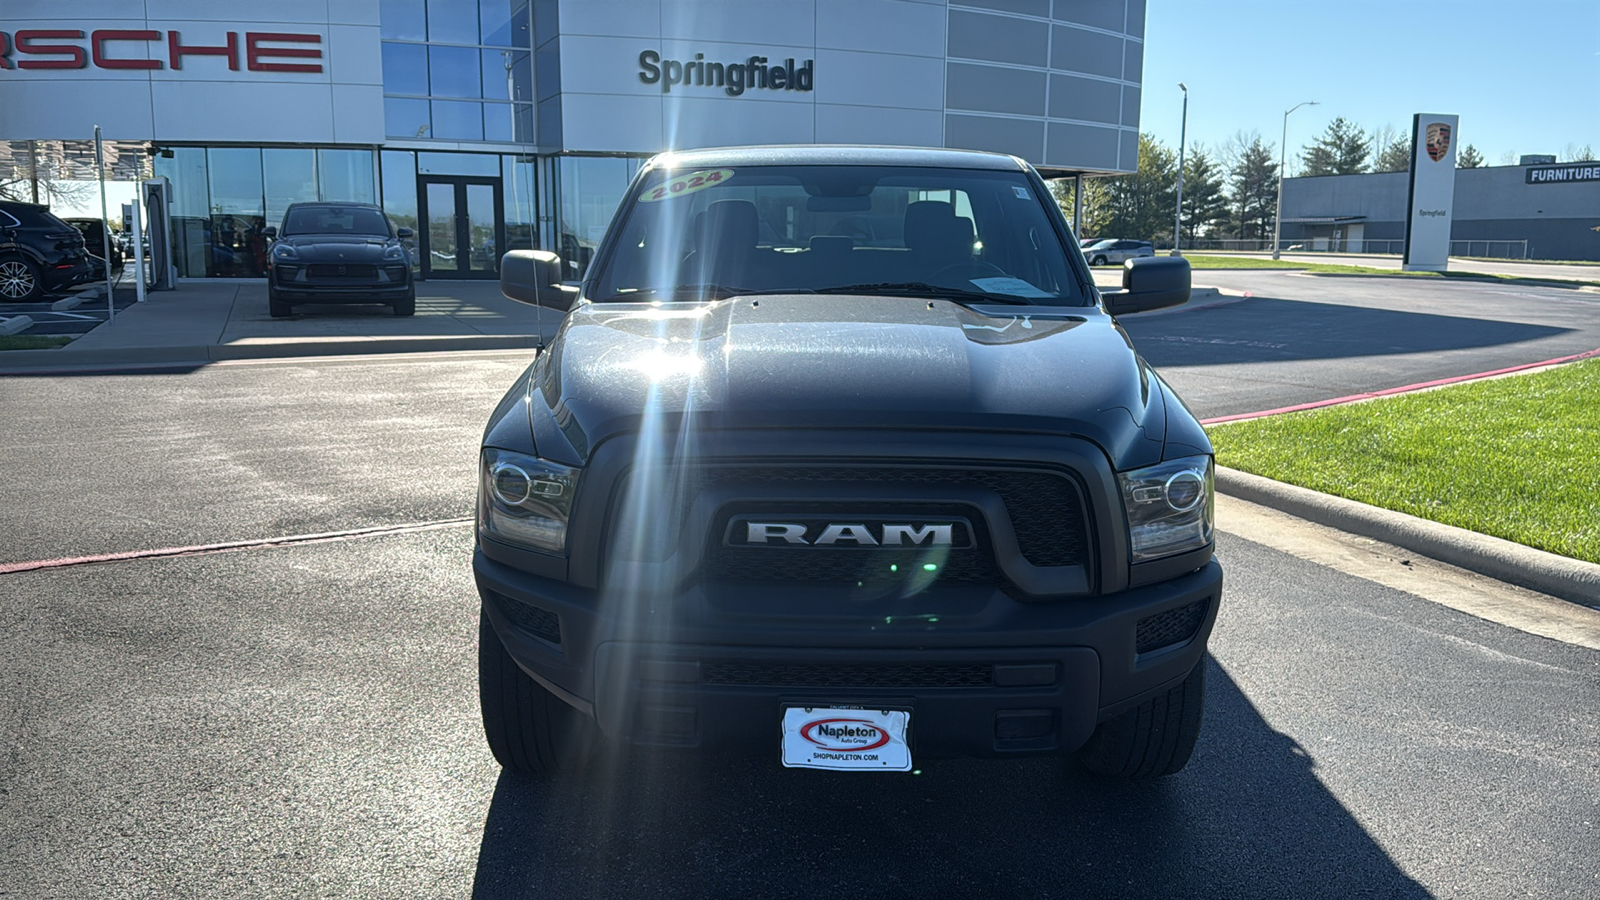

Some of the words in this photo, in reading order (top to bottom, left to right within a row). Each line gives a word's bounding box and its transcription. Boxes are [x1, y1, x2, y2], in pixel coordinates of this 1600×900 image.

[0, 29, 323, 73] SCHE
[638, 50, 814, 96] Springfield
[1531, 167, 1600, 182] FURNITURE
[652, 171, 723, 200] 2024
[1419, 209, 1446, 218] Springfield
[747, 522, 953, 546] RAM
[818, 724, 876, 739] Napleton
[813, 752, 878, 761] SHOPNAPLETON.COM
